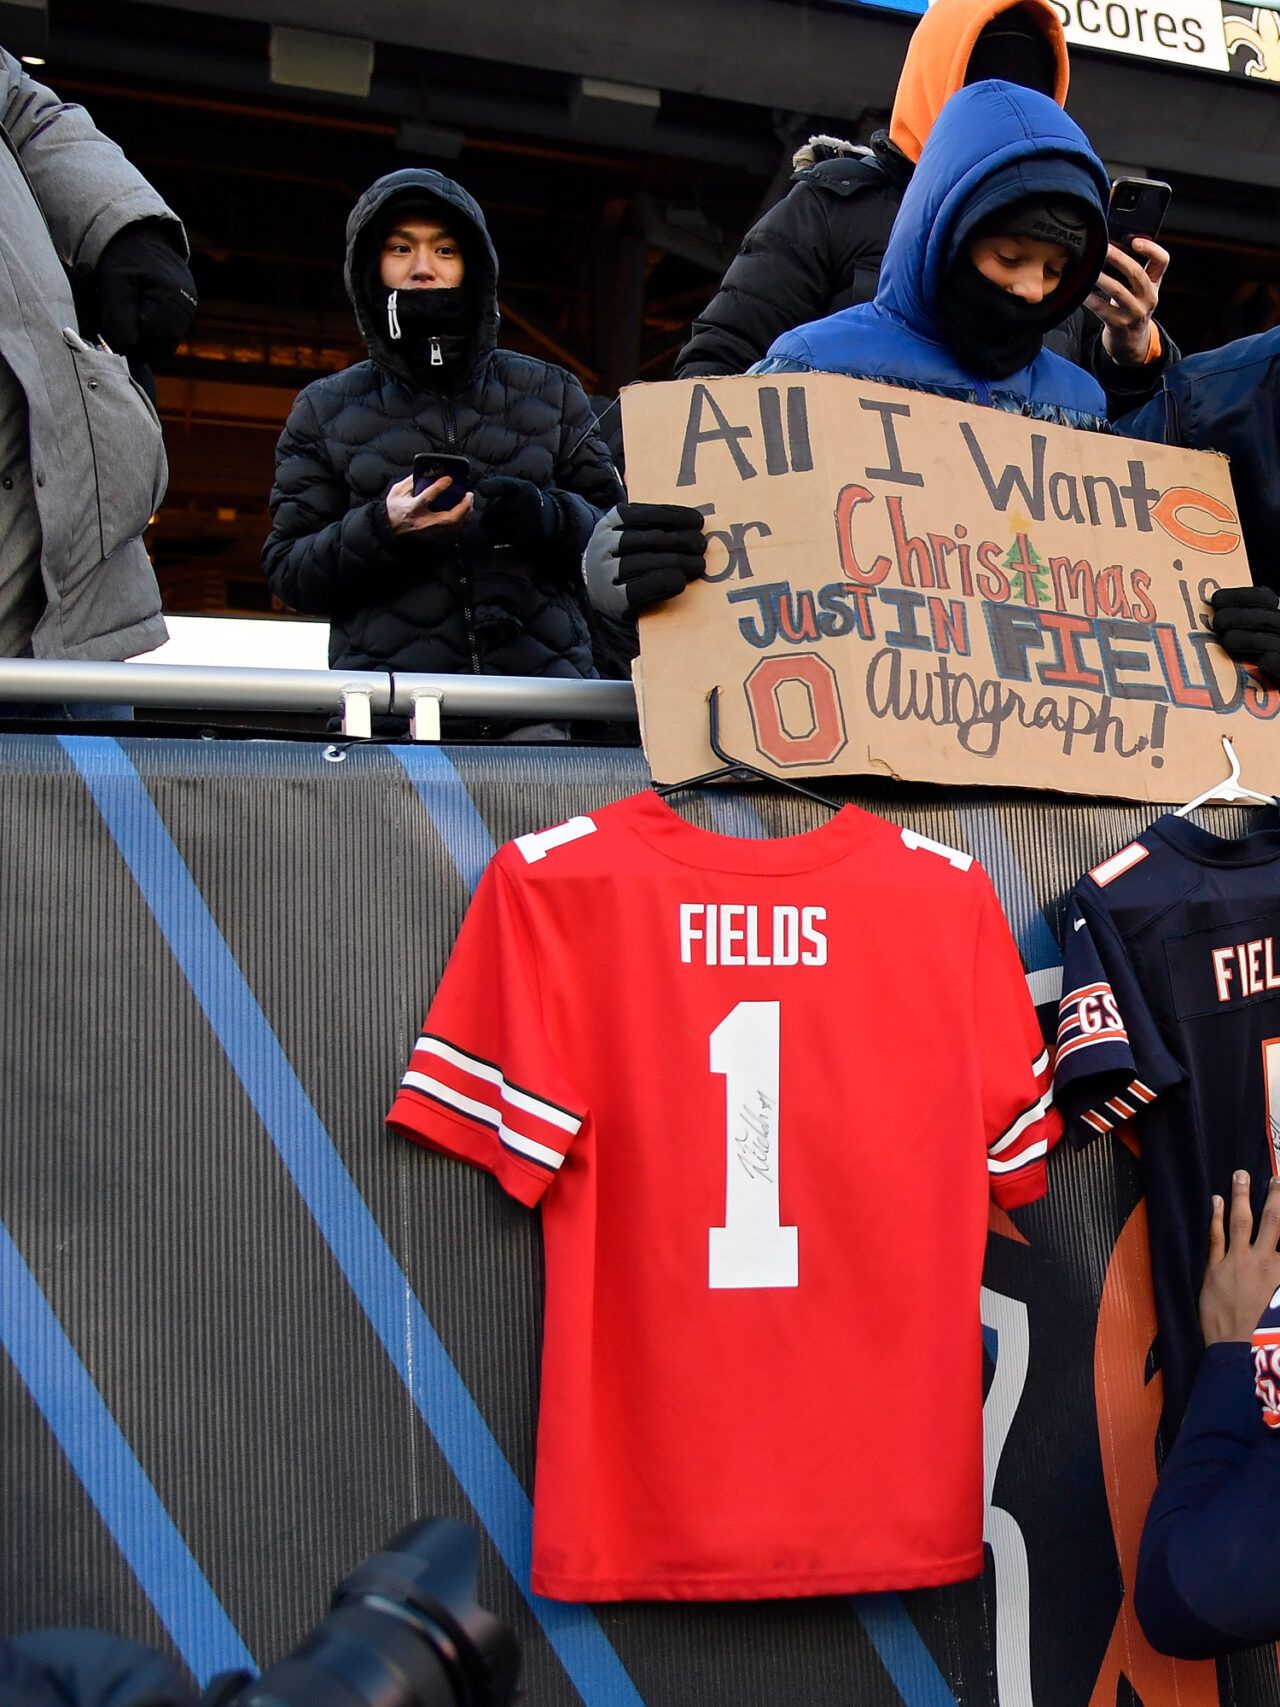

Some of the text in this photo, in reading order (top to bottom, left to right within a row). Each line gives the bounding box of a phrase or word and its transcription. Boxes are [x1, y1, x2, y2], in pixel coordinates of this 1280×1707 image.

[676, 384, 1161, 532] All I Want
[694, 503, 772, 583] or
[835, 483, 1157, 624] Christmas
[679, 903, 828, 966] FIELDS
[708, 1001, 799, 1289] 1
